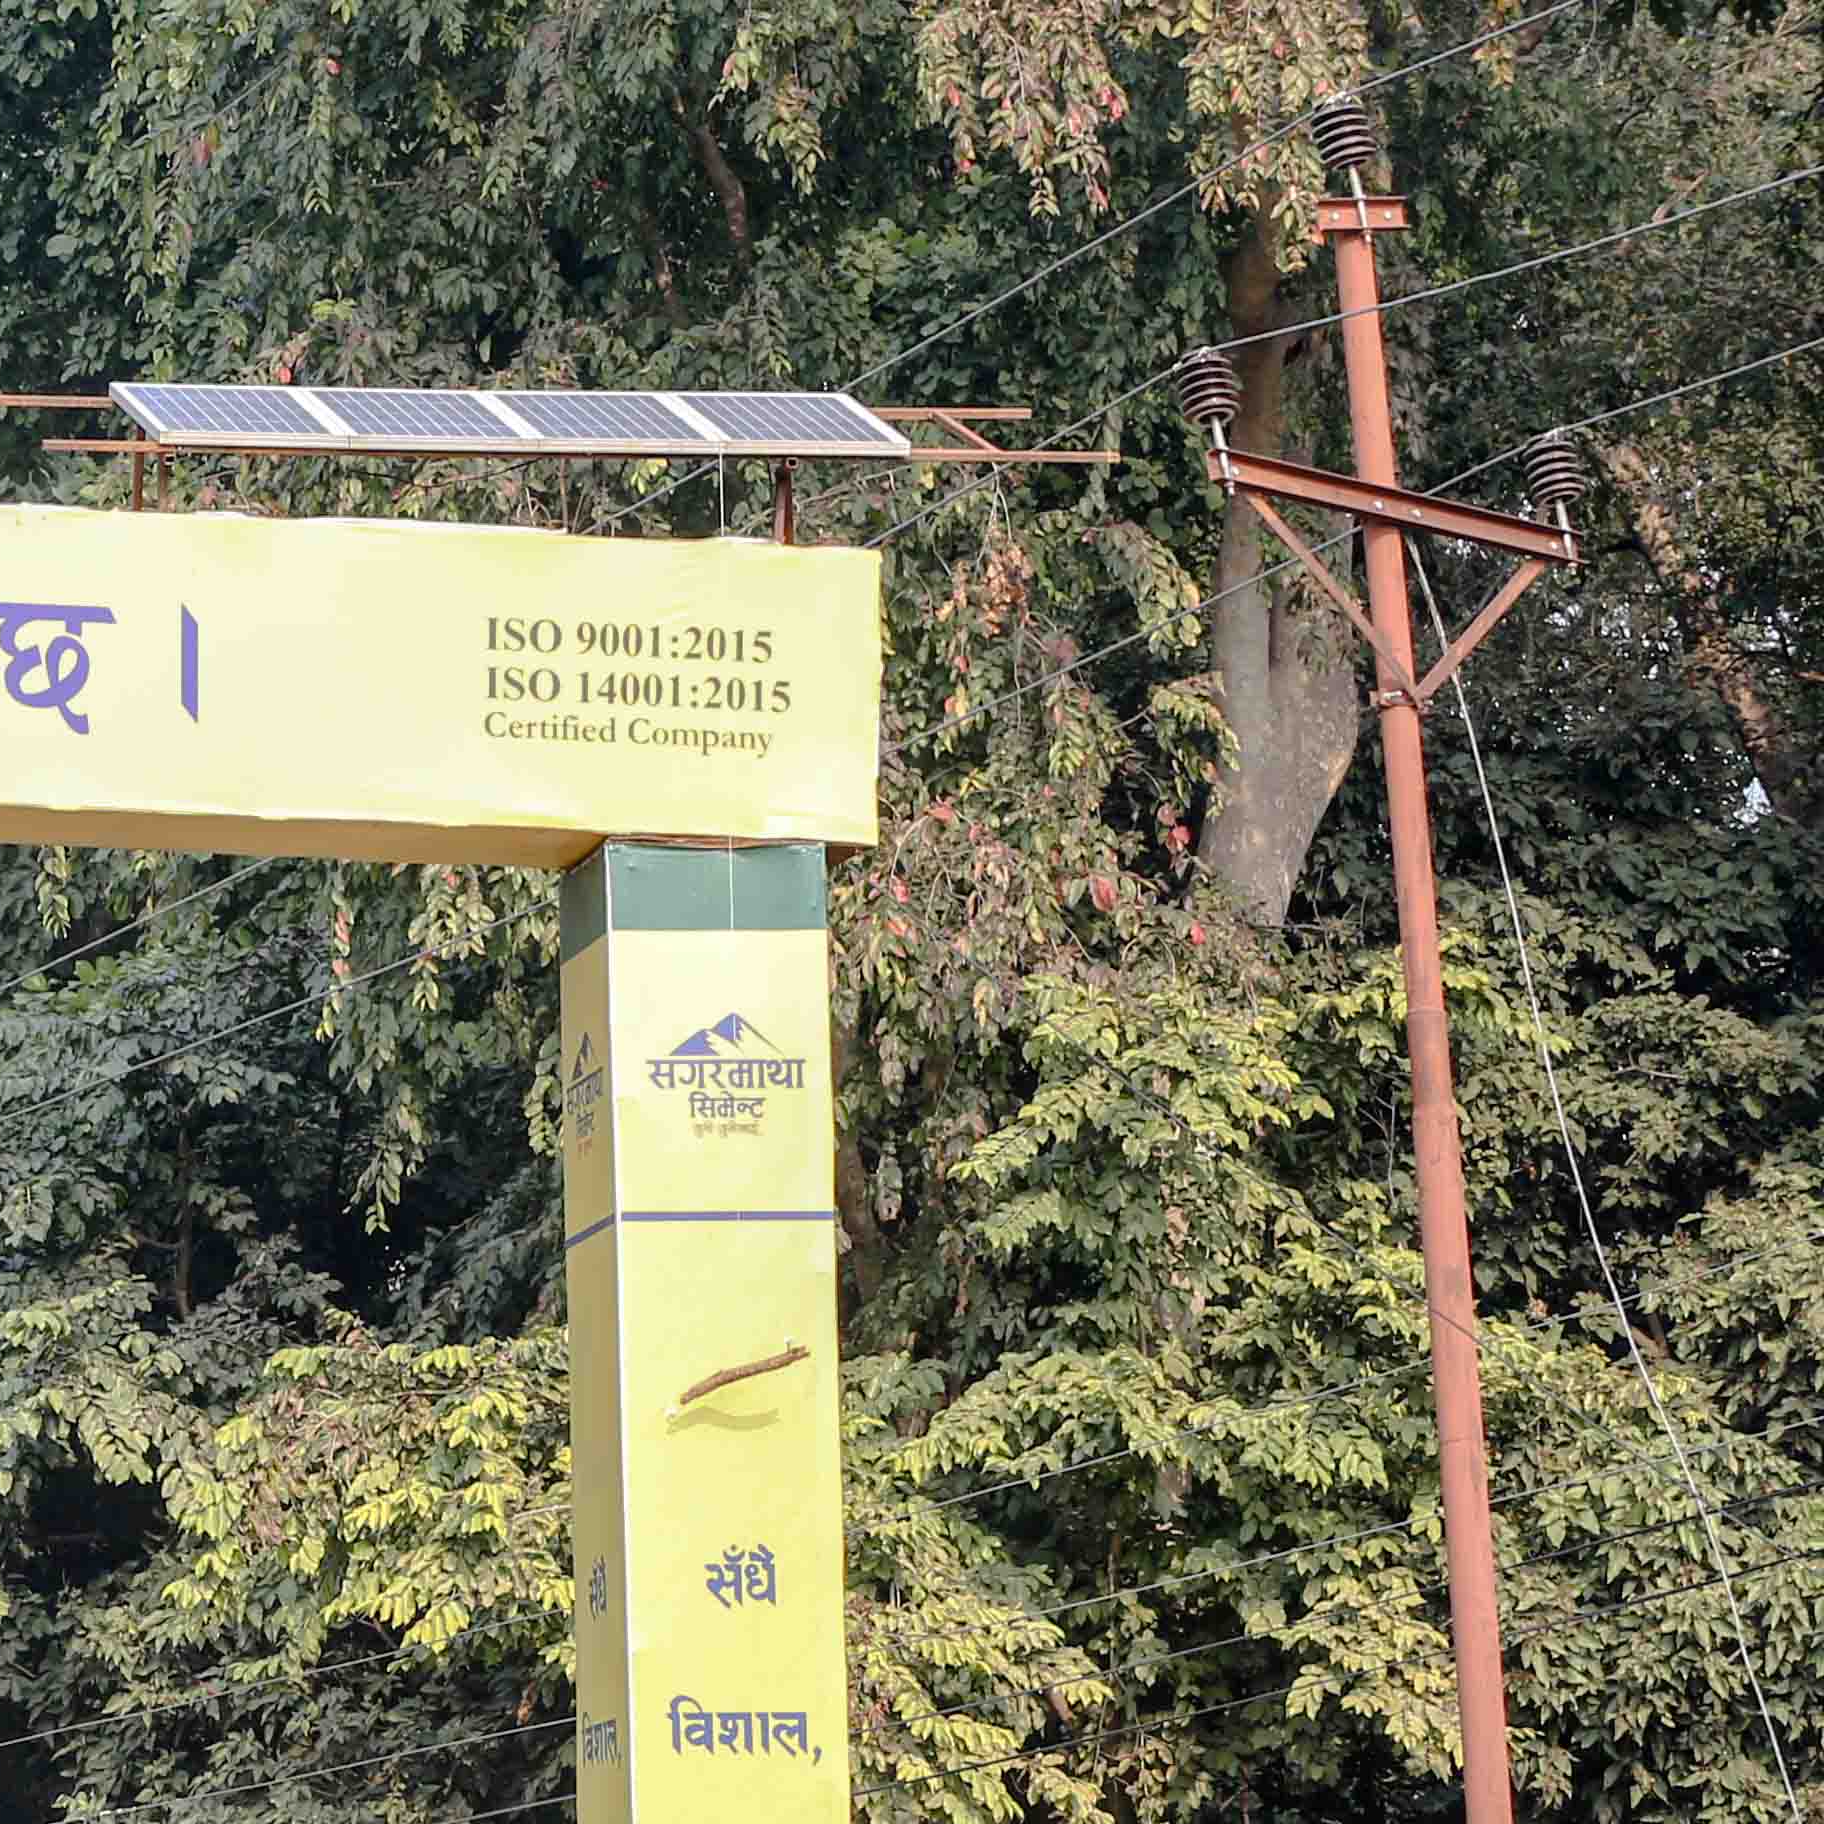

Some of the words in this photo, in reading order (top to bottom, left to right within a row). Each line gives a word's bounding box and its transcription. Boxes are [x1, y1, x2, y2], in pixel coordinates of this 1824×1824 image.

[486, 617, 561, 655] ISO
[576, 621, 774, 664] 9001:2015
[485, 667, 561, 704] ISO
[577, 669, 792, 713] 14001:2015
[484, 711, 617, 744] Certified
[628, 718, 774, 758] Company
[645, 1058, 807, 1089] सगरमाथा
[688, 1091, 767, 1118] सिमेन्ट
[666, 1695, 822, 1766] विशाल,
